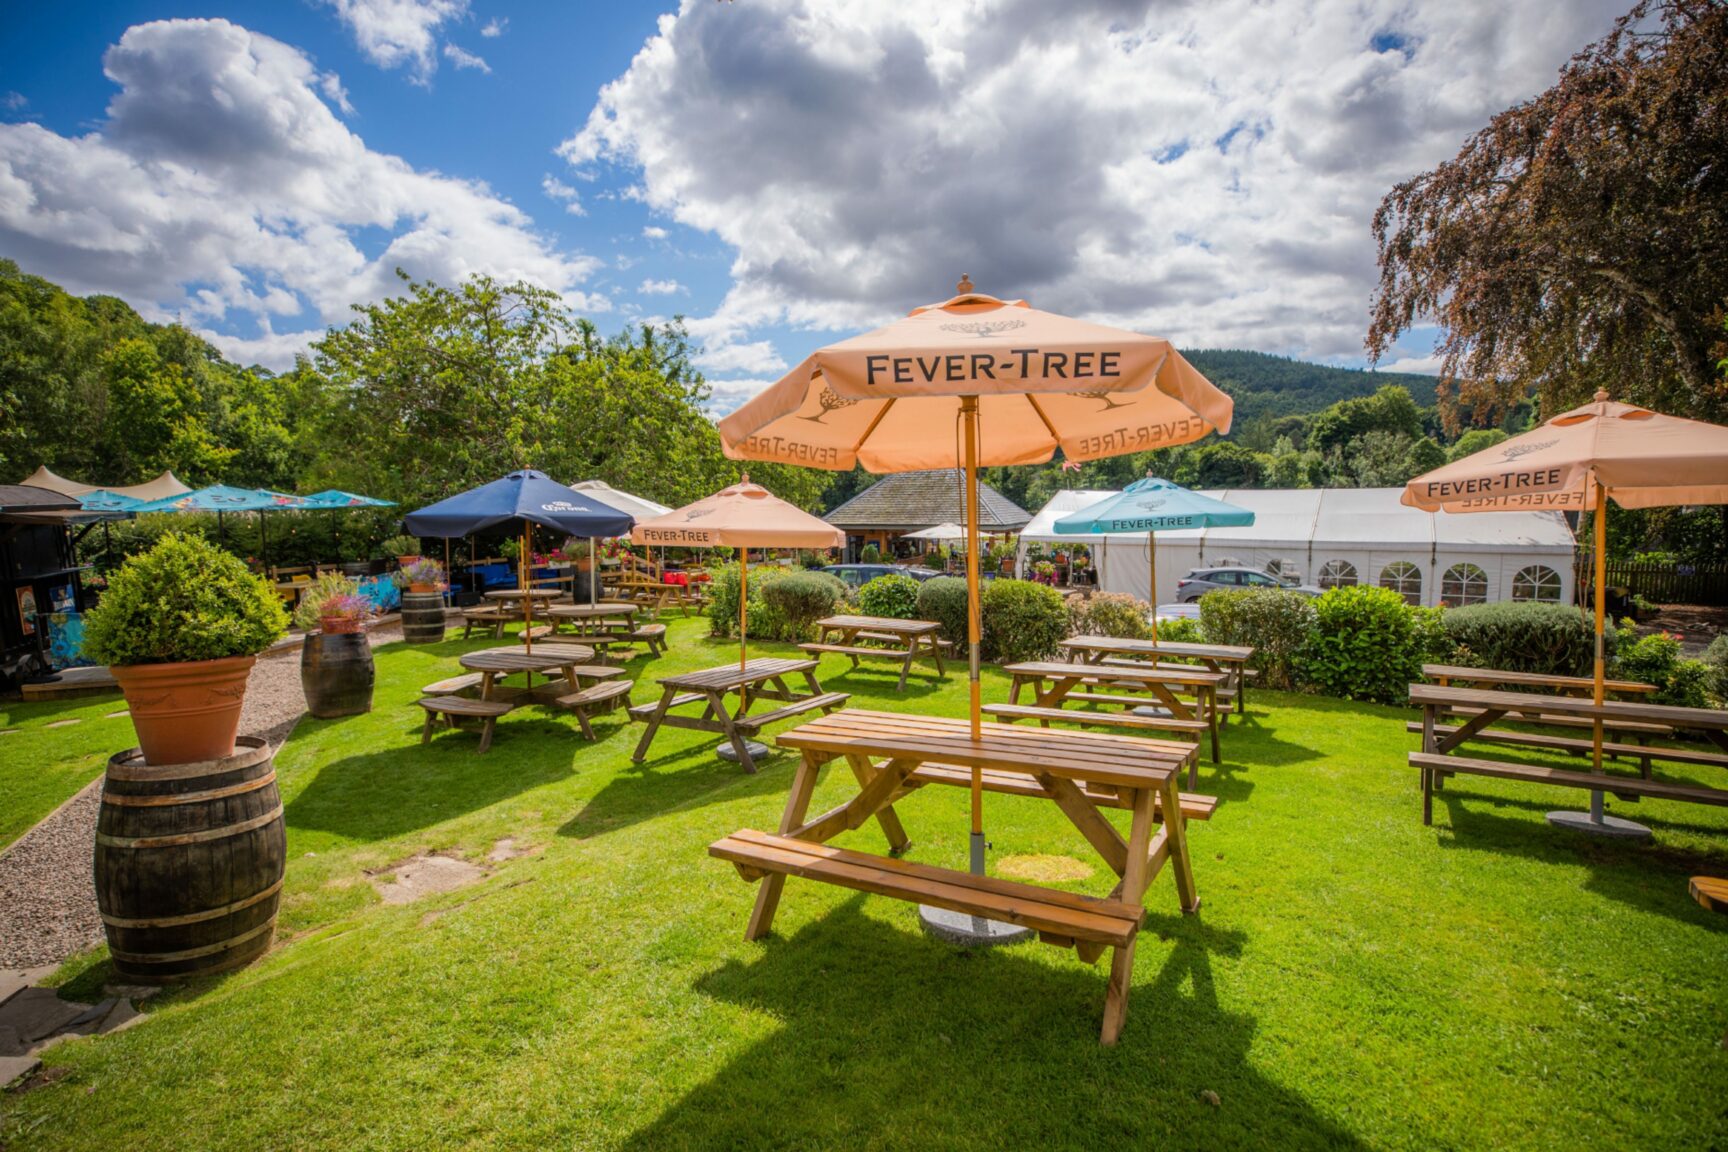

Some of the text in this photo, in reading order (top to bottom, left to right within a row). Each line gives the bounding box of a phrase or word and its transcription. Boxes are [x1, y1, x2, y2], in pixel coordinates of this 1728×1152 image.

[866, 348, 1122, 385] FEVER-TREE
[1427, 468, 1561, 498] FEVER-TREE
[1112, 516, 1193, 530] FEVER-TREE
[643, 529, 709, 542] FEVER-TREE
